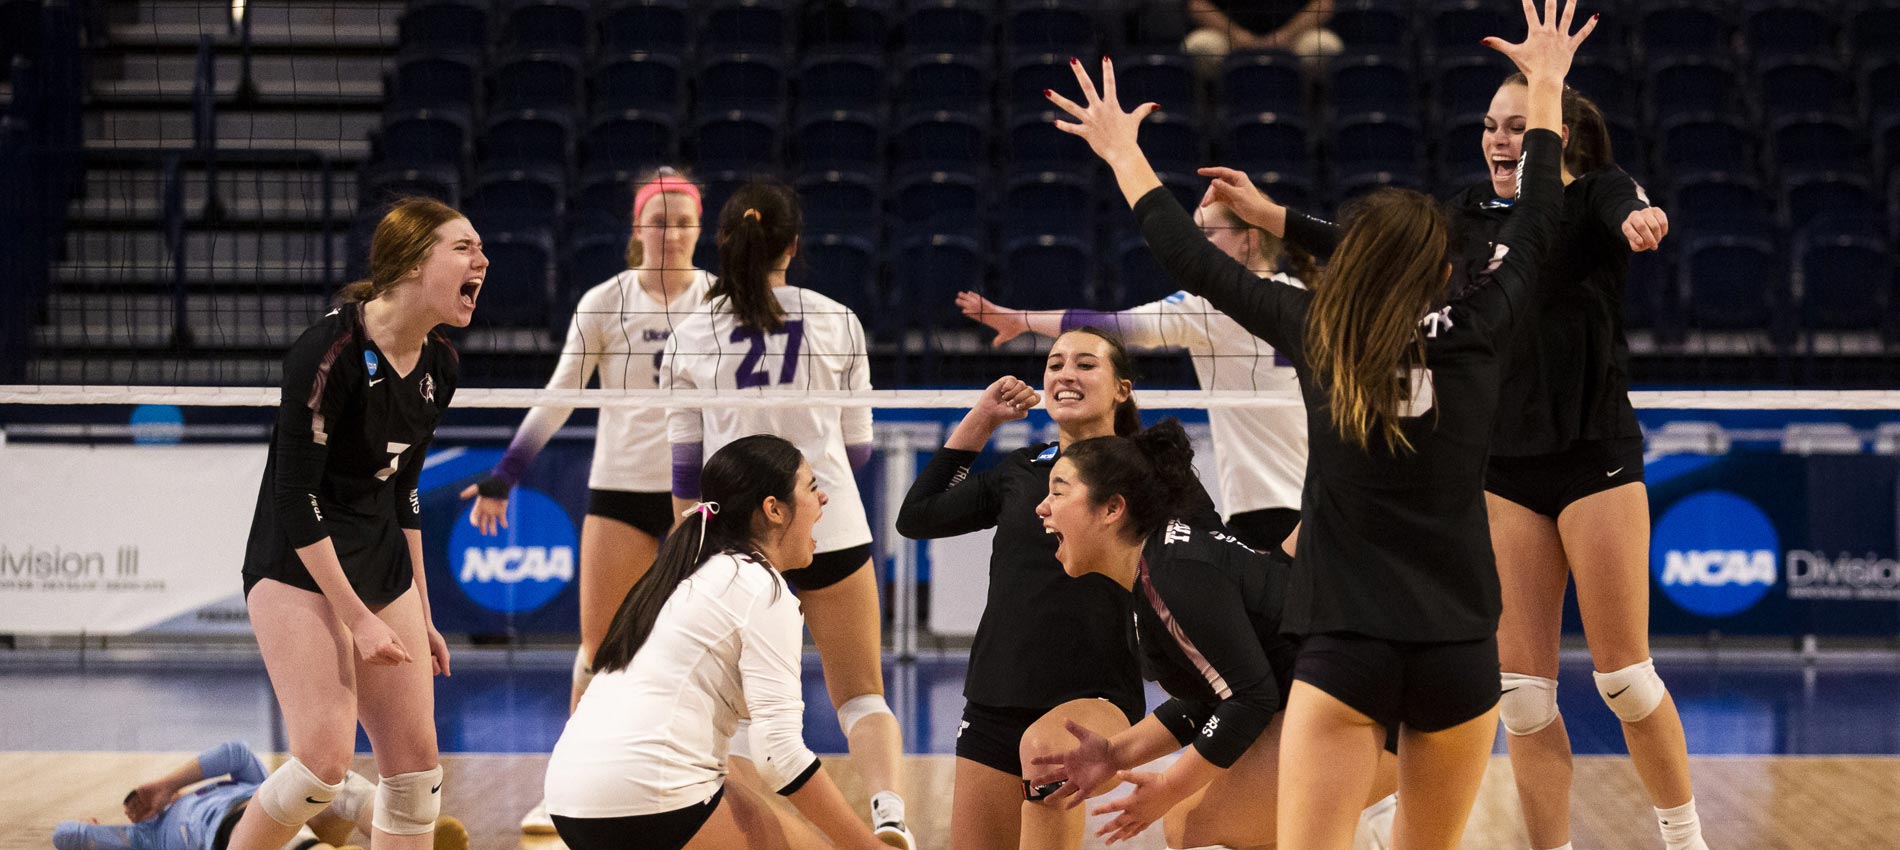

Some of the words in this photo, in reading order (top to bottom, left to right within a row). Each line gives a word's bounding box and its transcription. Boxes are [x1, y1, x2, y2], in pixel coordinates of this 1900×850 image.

[730, 320, 803, 389] 27
[0, 545, 104, 578] ivision
[116, 545, 139, 575] III
[461, 546, 574, 582] NCAA
[1662, 550, 1776, 586] NCAA
[1786, 550, 1900, 587] Divisio
